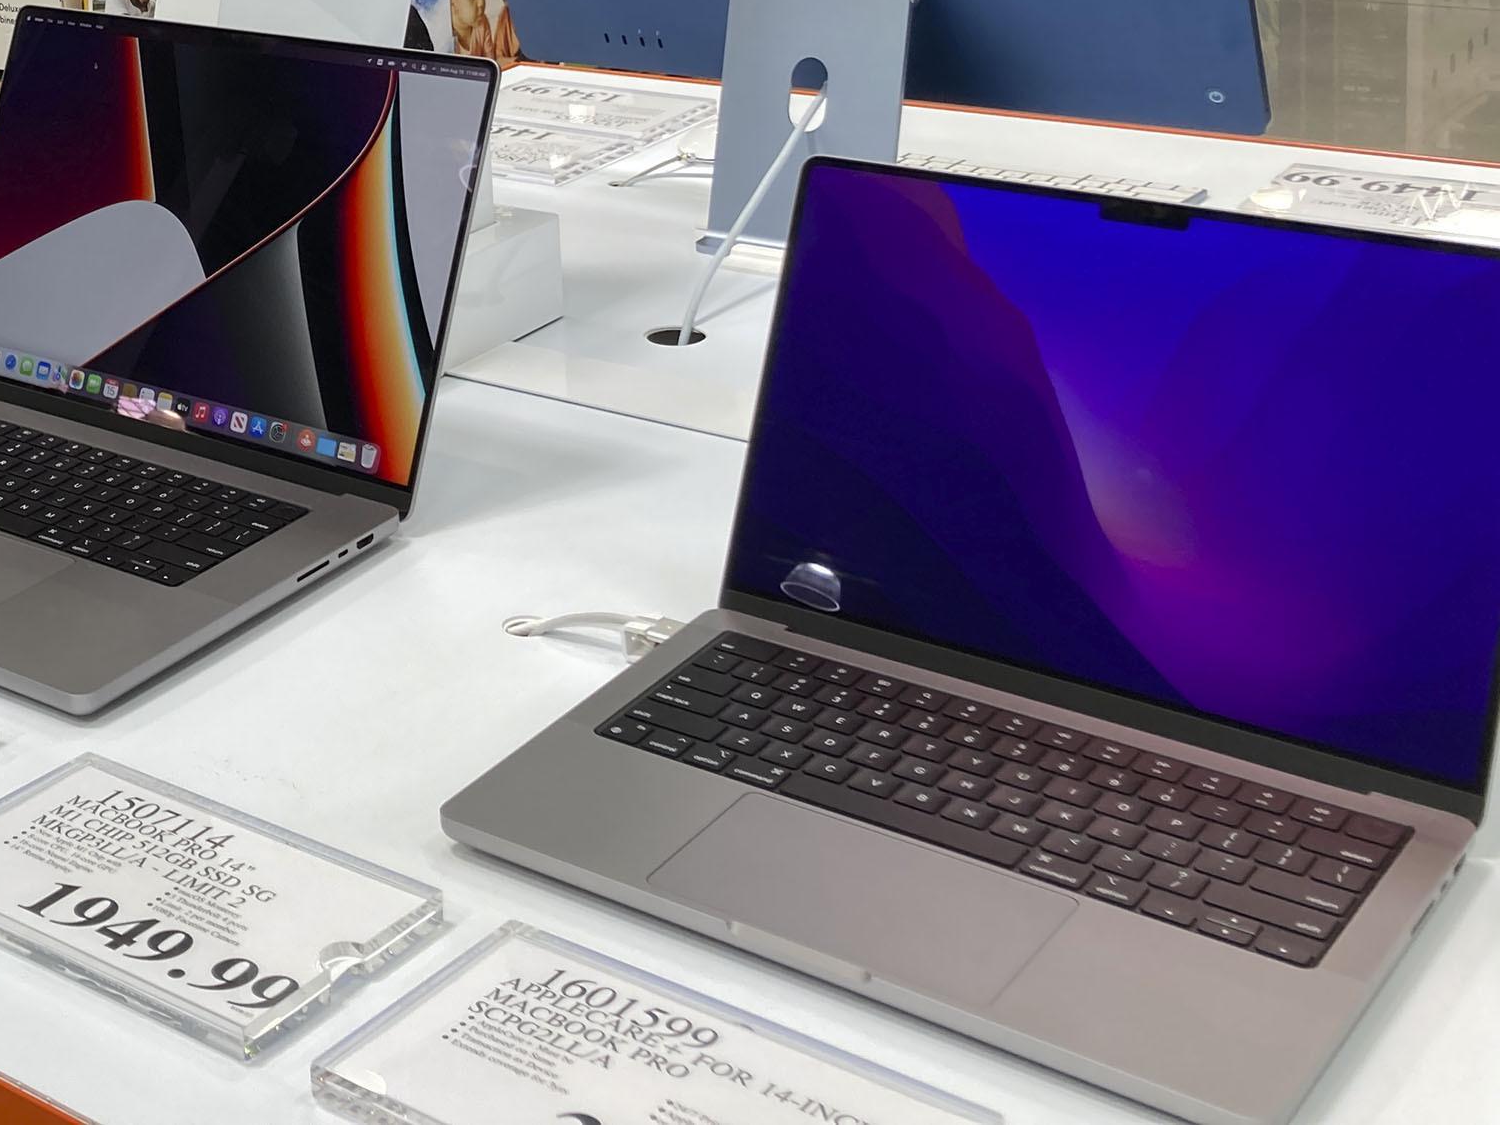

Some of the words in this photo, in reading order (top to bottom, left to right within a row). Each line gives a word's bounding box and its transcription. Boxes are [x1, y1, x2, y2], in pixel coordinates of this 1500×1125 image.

[0, 2, 19, 13] Delux
[32, 814, 147, 868] MKGP3LL/A
[163, 869, 231, 901] LIMIT
[227, 896, 246, 909] 2
[50, 805, 82, 822] M1
[83, 818, 134, 842] CHIP
[132, 839, 198, 871] 512GB
[197, 865, 242, 889] SSD
[241, 884, 277, 903] SG
[67, 795, 174, 842] MACBOOK
[172, 837, 217, 860] PRO
[219, 857, 257, 872] 14"
[98, 789, 235, 849] 1507114
[17, 882, 300, 1009] 1949.99
[468, 1001, 616, 1069] SCPG2LL/A
[485, 988, 625, 1053] MACBOOK
[630, 1047, 691, 1079] PRO
[500, 977, 685, 1055] APPLECARE+
[692, 1052, 753, 1087] FOR
[760, 1082, 880, 1125] 14-INC
[532, 969, 719, 1049] 1601599
